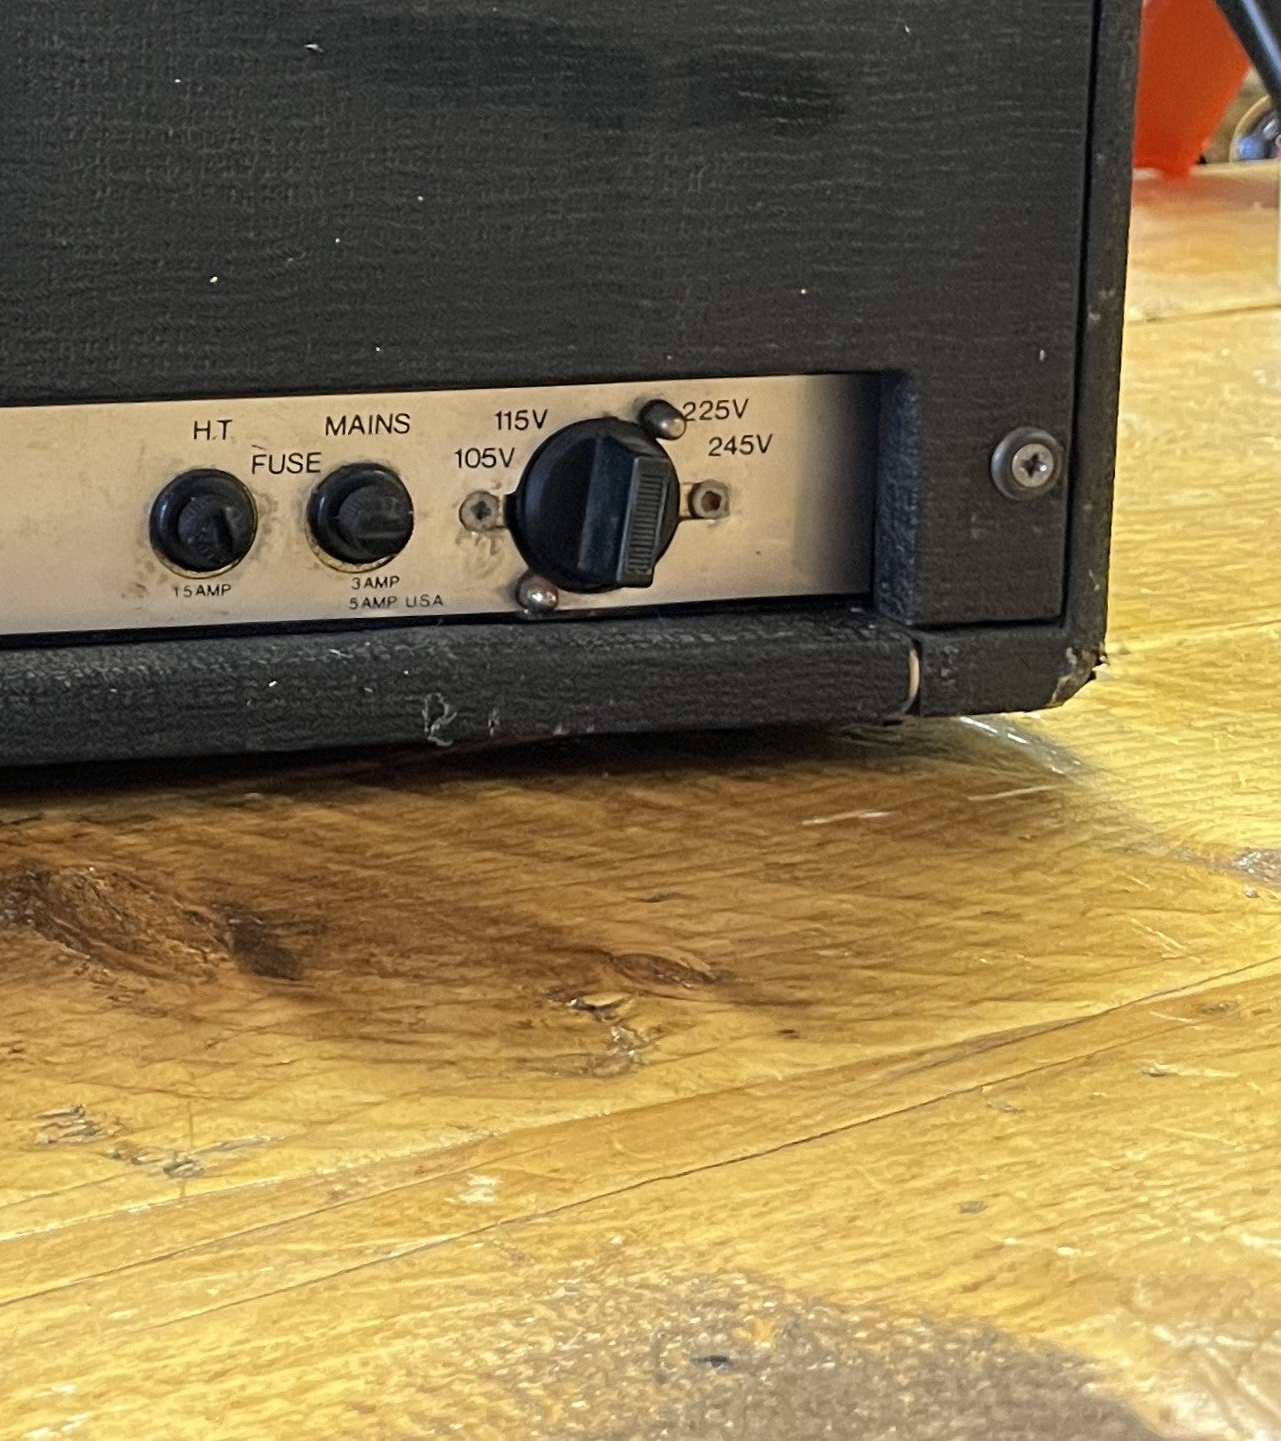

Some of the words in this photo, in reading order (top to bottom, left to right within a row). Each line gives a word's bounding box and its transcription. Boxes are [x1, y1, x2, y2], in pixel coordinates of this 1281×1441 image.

[494, 408, 548, 431] 115V
[682, 398, 750, 422] 225V
[325, 413, 411, 436] MAINS
[708, 434, 773, 456] 245V
[251, 452, 322, 475] FUSE
[454, 447, 515, 469] 105V
[405, 594, 444, 608] USA
